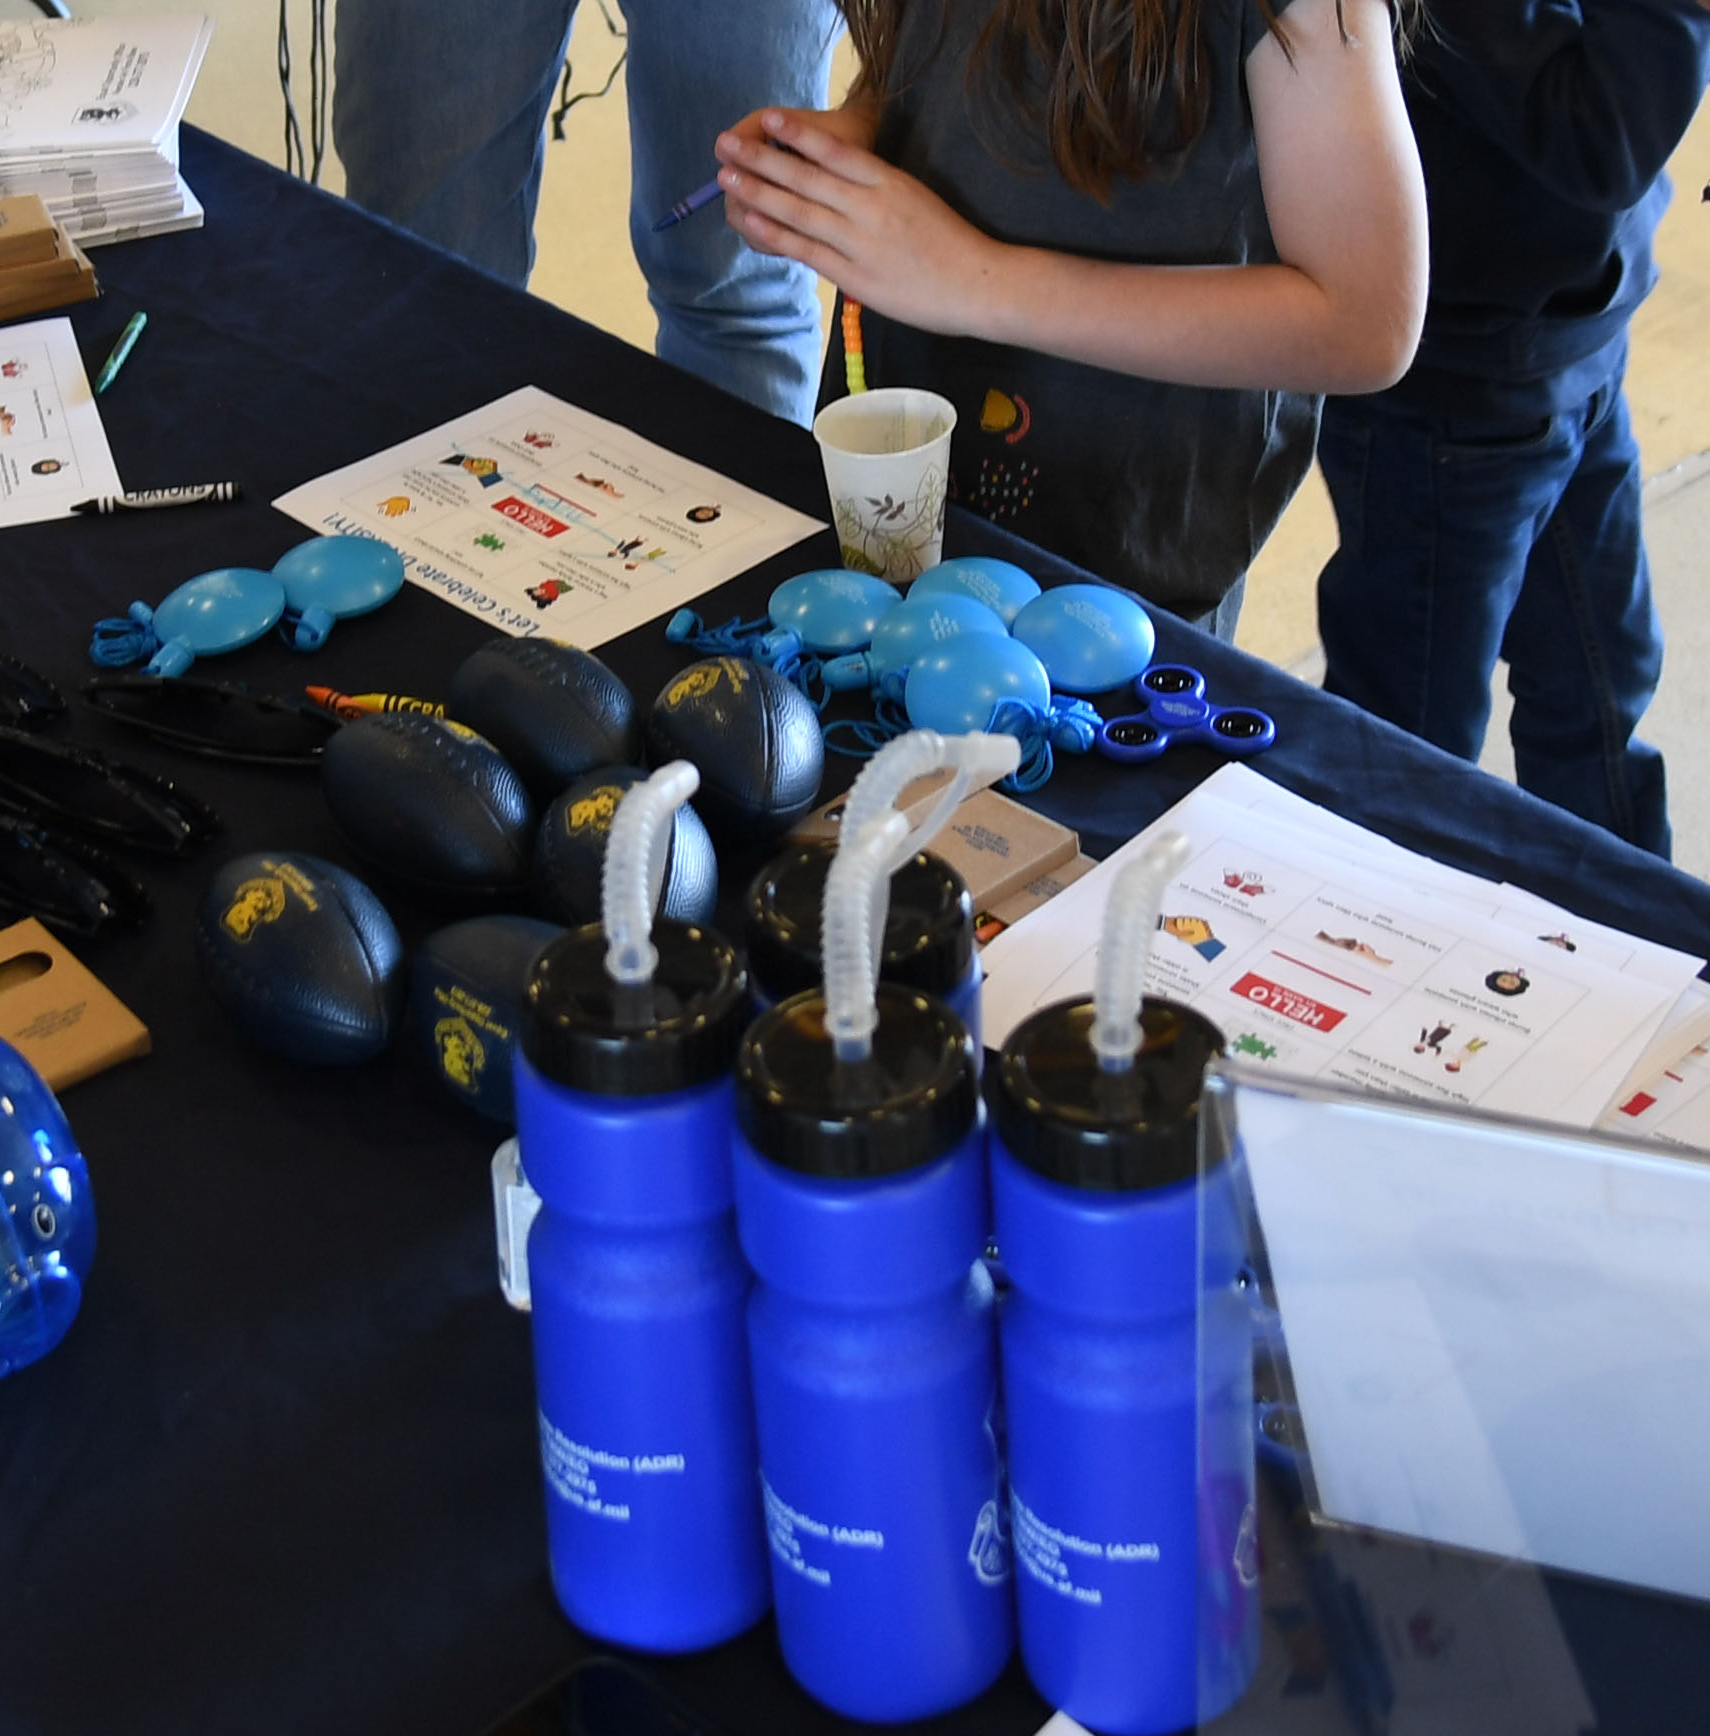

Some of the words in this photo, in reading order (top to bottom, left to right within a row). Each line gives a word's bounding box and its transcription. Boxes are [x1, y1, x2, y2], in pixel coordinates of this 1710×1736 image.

[501, 503, 555, 534] HELLO
[413, 561, 499, 614] Celebrate
[490, 604, 541, 637] Let's
[1248, 984, 1326, 1027] HELLO
